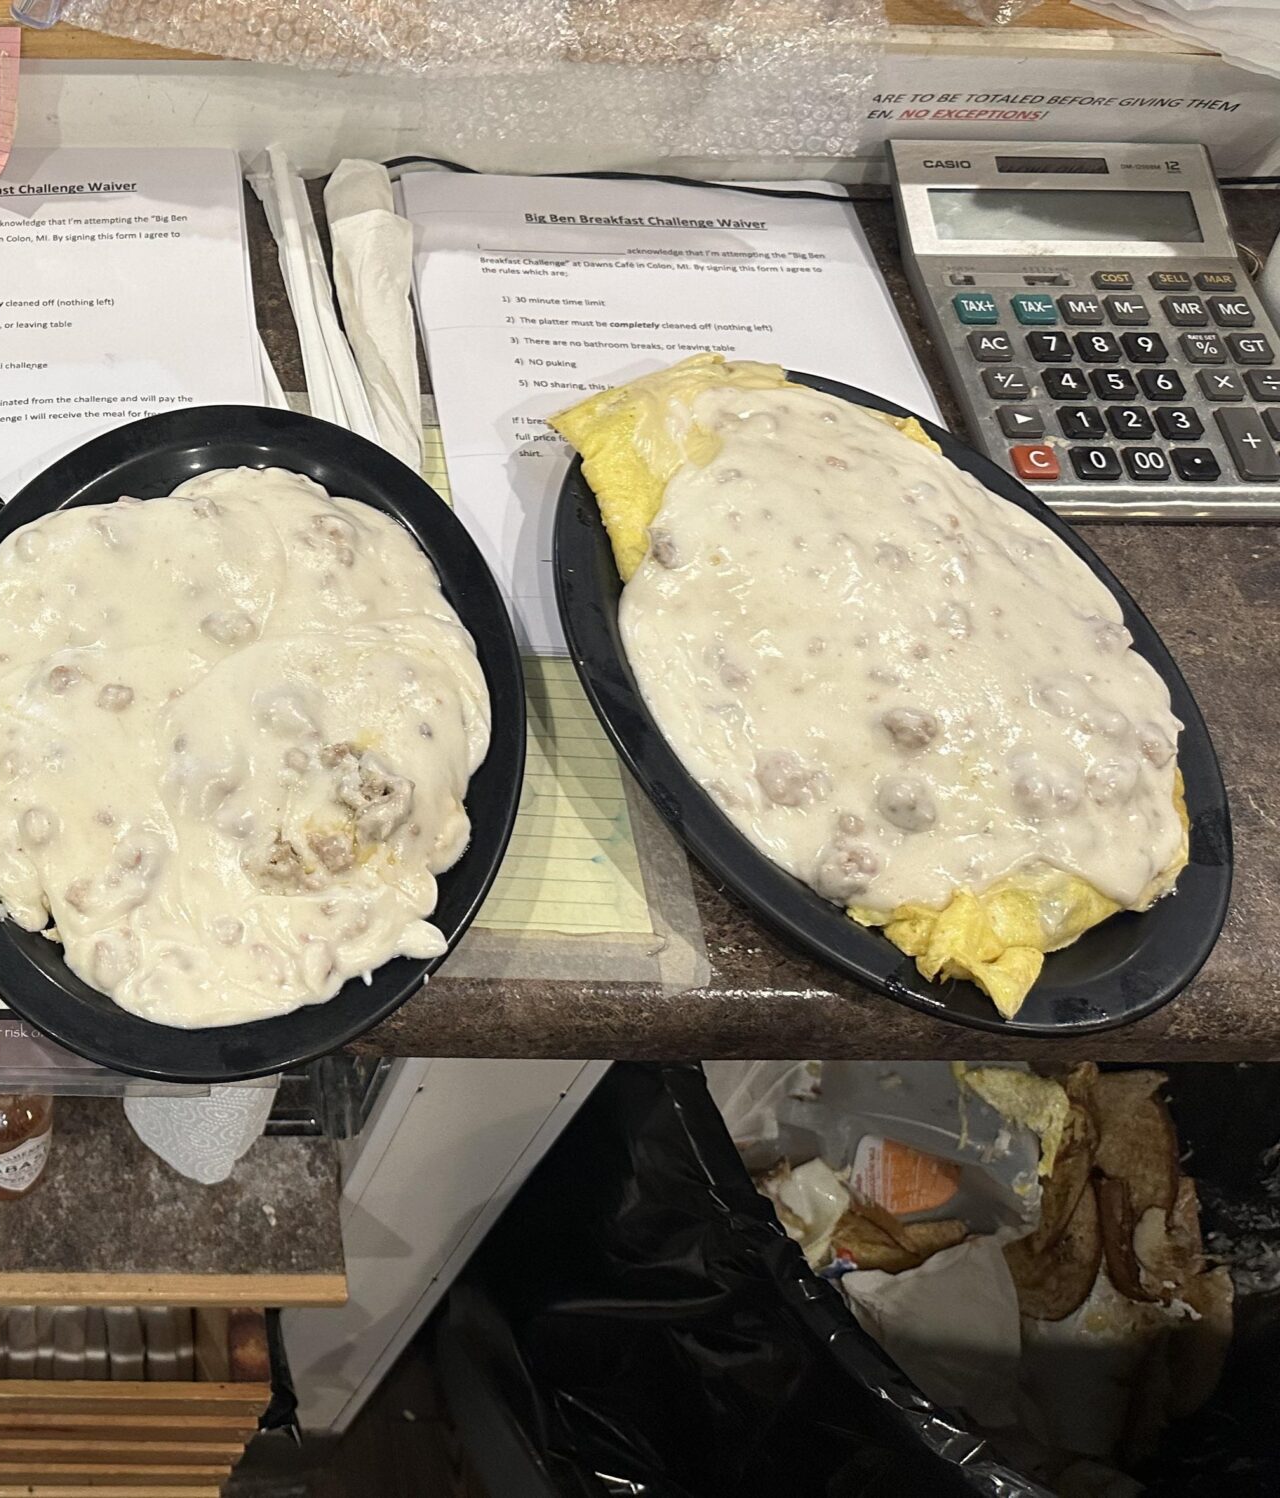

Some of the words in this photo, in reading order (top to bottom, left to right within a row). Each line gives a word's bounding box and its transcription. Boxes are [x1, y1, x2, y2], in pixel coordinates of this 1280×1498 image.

[872, 93, 907, 103] ARE
[909, 93, 935, 102] TO
[935, 93, 962, 102] BE
[965, 93, 1044, 103] TOTALED
[1045, 95, 1118, 105] BEFORE
[1118, 97, 1184, 107] GIVING
[1186, 98, 1241, 111] THEM
[899, 109, 928, 120] NO
[931, 109, 1048, 121] EXCEPTIONS!
[923, 159, 972, 170] CASIO
[1164, 160, 1180, 170] 12
[19, 182, 84, 195] Challenge
[87, 181, 137, 192] Waiver
[48, 219, 66, 227] that
[68, 218, 82, 226] I'm
[84, 217, 132, 228] attempting
[133, 216, 149, 224] the
[171, 214, 188, 223] Ben
[524, 213, 547, 224] Big
[549, 214, 576, 224] Ben
[579, 214, 644, 226] Breakfast
[648, 216, 714, 229] Challenge
[716, 218, 767, 229] Waiver
[35, 232, 49, 241] MI.
[52, 234, 63, 242] By
[64, 233, 96, 242] signing
[1101, 273, 1129, 282] COST
[1159, 273, 1189, 283] SELL
[1203, 274, 1232, 284] MAR
[56, 298, 94, 306] (nothing
[96, 298, 114, 306] left)
[501, 295, 511, 303] 1)
[963, 301, 995, 312] TAX+
[1069, 302, 1097, 313] M+
[1173, 302, 1200, 315] MR
[1218, 303, 1251, 316] MC
[980, 337, 1009, 349] AC
[1042, 336, 1057, 351] 7
[1093, 336, 1110, 353] 8
[1137, 336, 1153, 353] 9
[1195, 341, 1217, 355] %
[1239, 340, 1264, 351] GT
[514, 357, 524, 365] 4)
[545, 360, 577, 368] puking
[1061, 373, 1077, 388] 4
[1107, 373, 1124, 390] 5
[1157, 374, 1173, 390] 6
[1076, 411, 1090, 428] 1
[1123, 411, 1142, 428] 2
[1172, 412, 1190, 429] 3
[1029, 451, 1049, 467] C
[1089, 450, 1107, 469] 0
[1134, 451, 1164, 469] 00
[4, 1024, 29, 1038] risk
